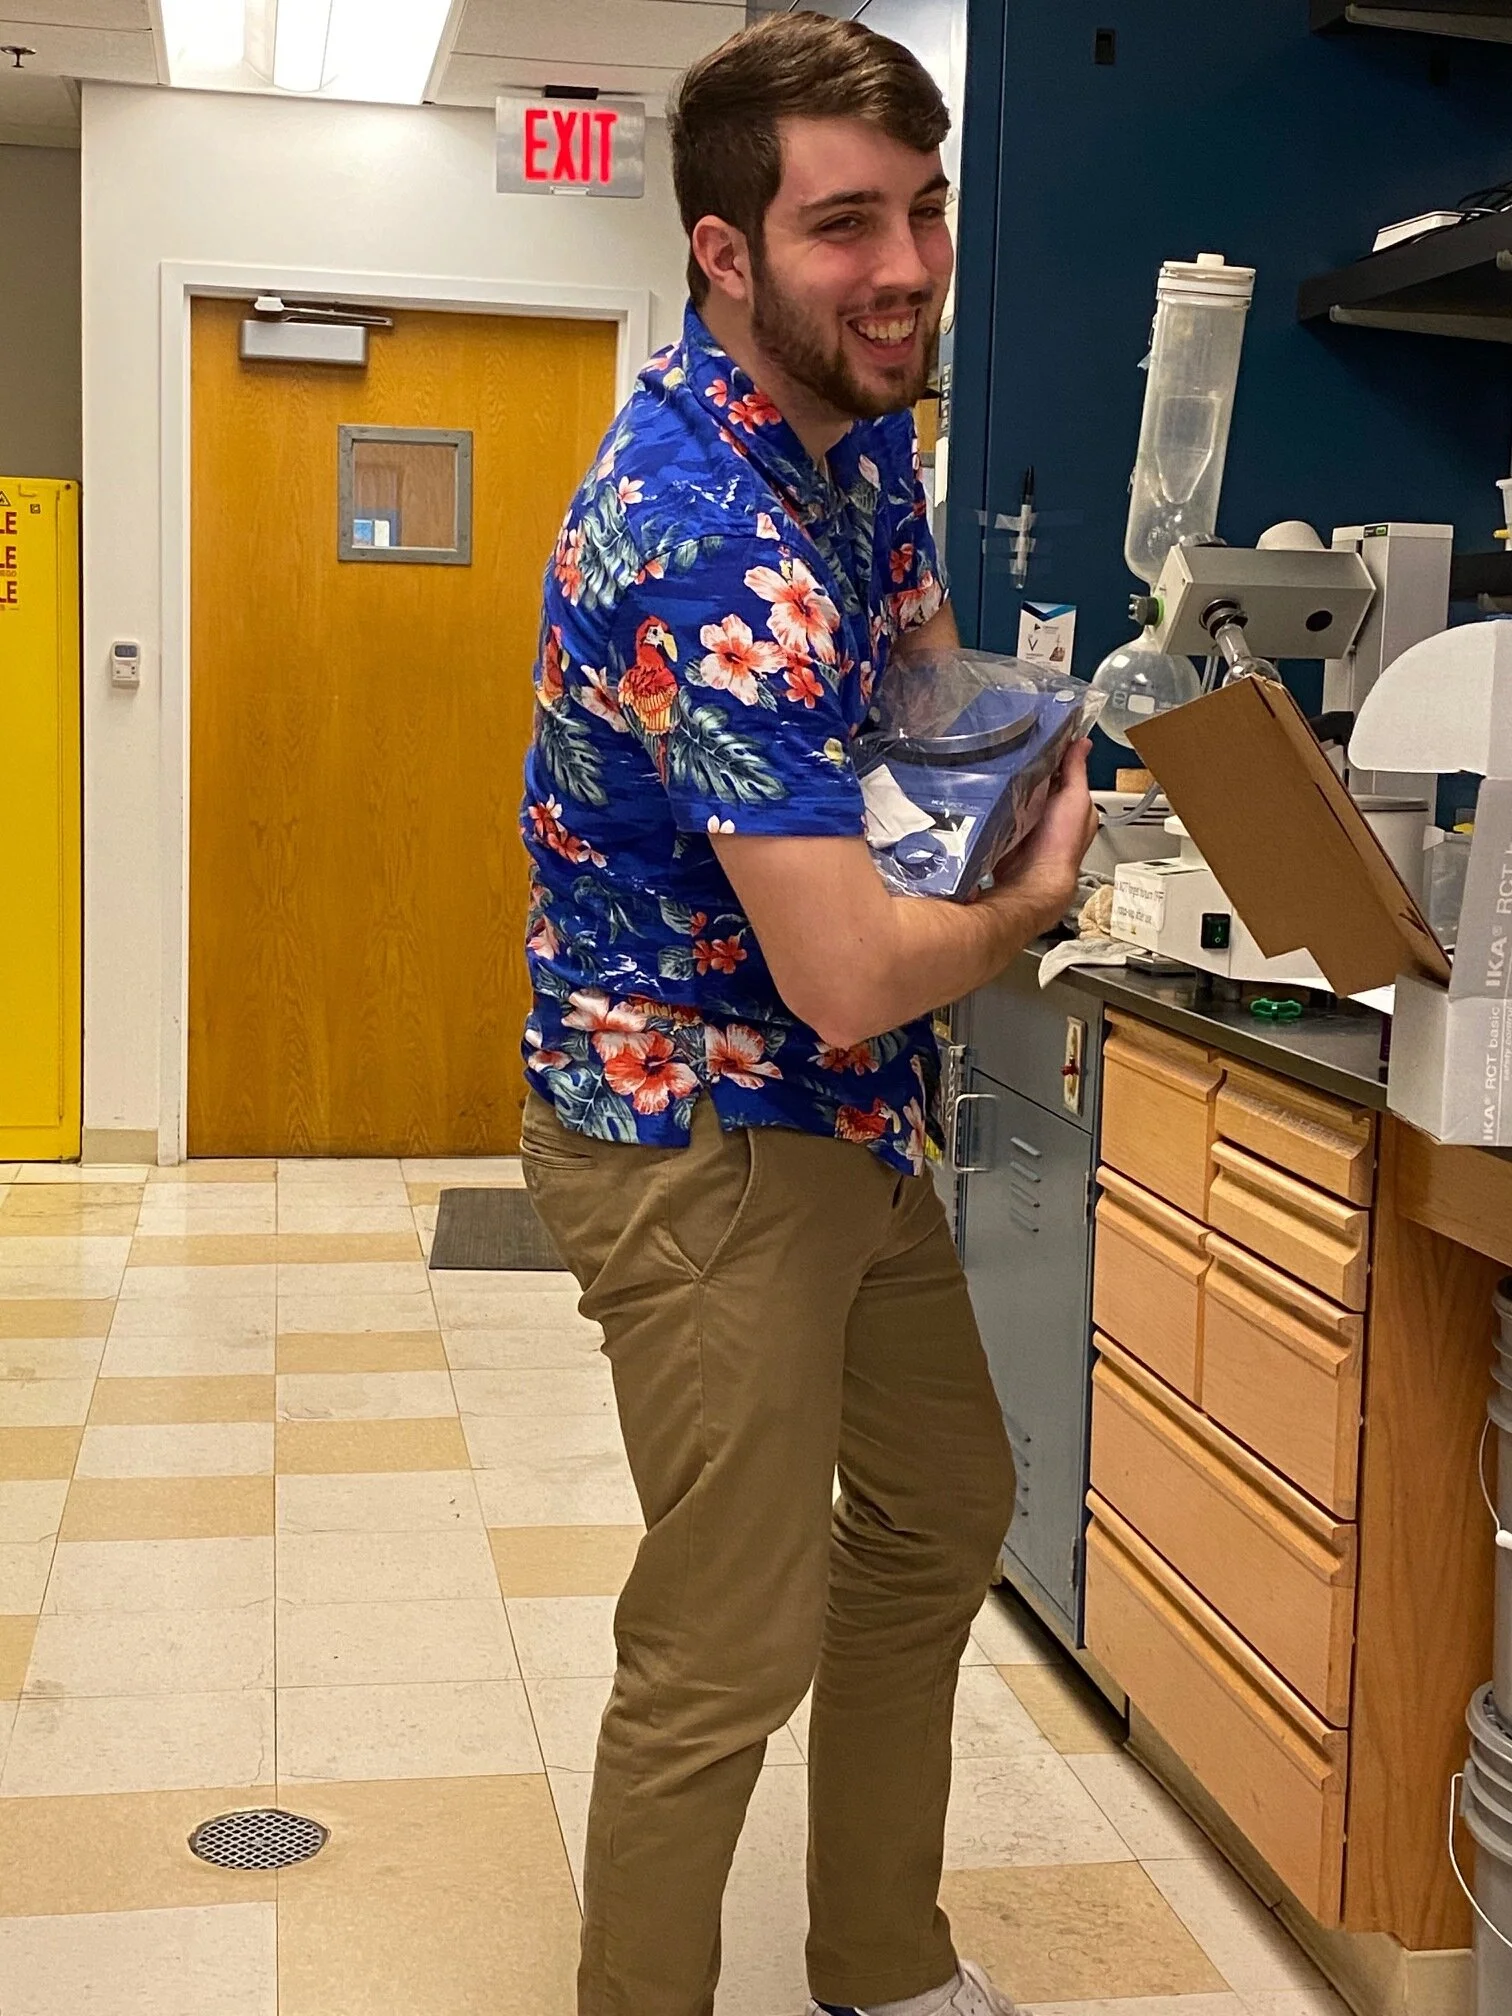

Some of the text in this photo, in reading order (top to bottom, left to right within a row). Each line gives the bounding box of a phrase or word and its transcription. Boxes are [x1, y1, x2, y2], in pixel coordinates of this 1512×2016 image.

[524, 108, 619, 183] EXIT
[1496, 863, 1512, 915] RCT
[1488, 1006, 1501, 1049] basic
[1485, 1053, 1498, 1090] RCT
